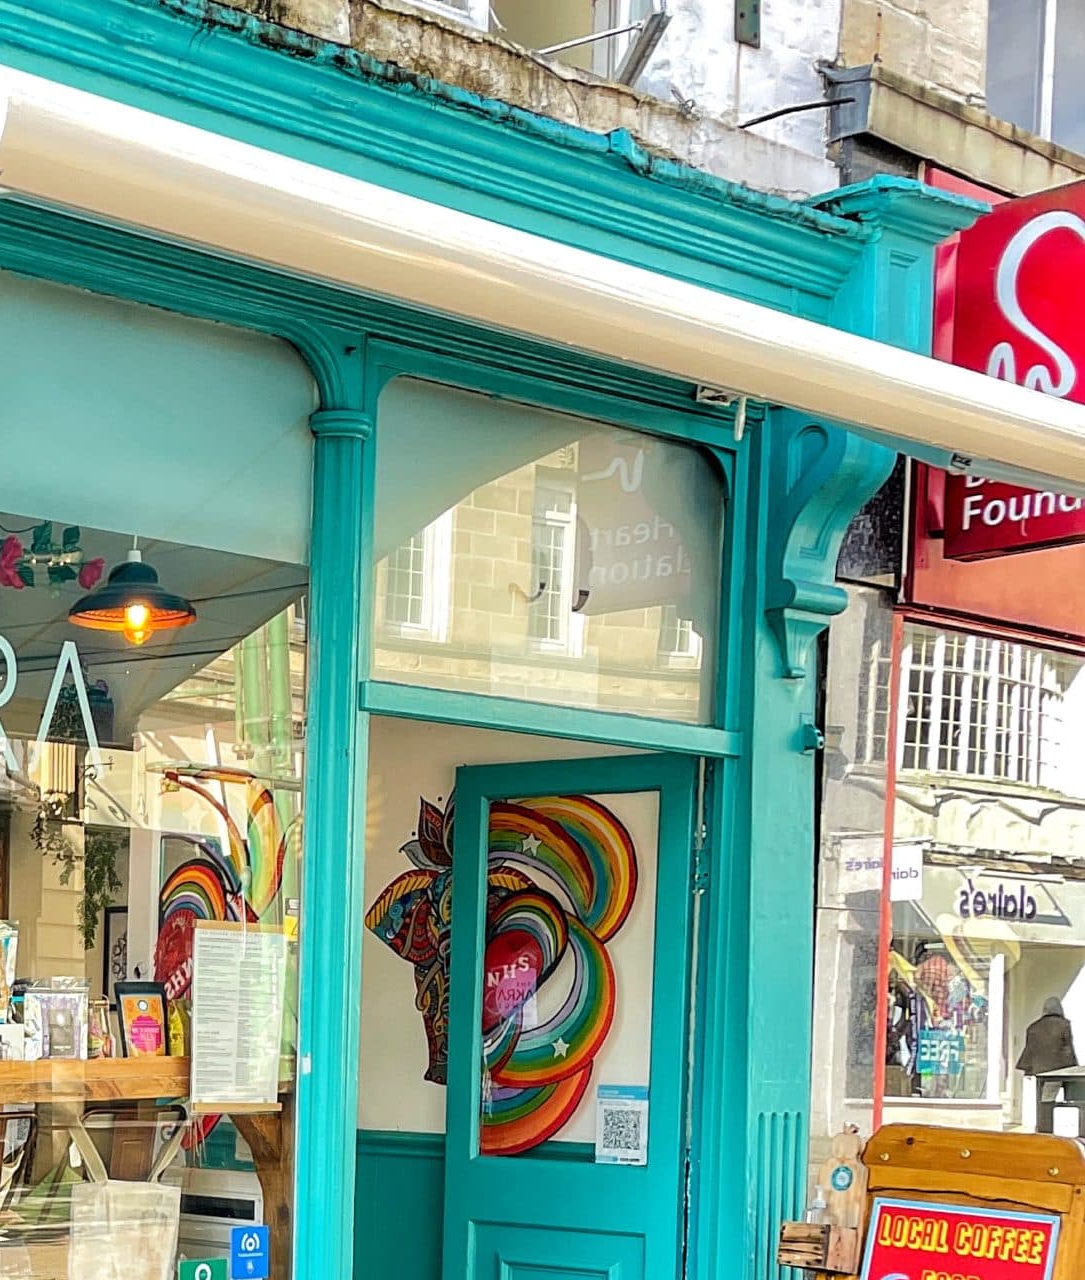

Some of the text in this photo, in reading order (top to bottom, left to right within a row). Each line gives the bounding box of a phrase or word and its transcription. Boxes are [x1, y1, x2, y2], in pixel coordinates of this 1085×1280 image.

[487, 956, 530, 988] NHS
[878, 1213, 1046, 1265] LOCAL COFFEE
